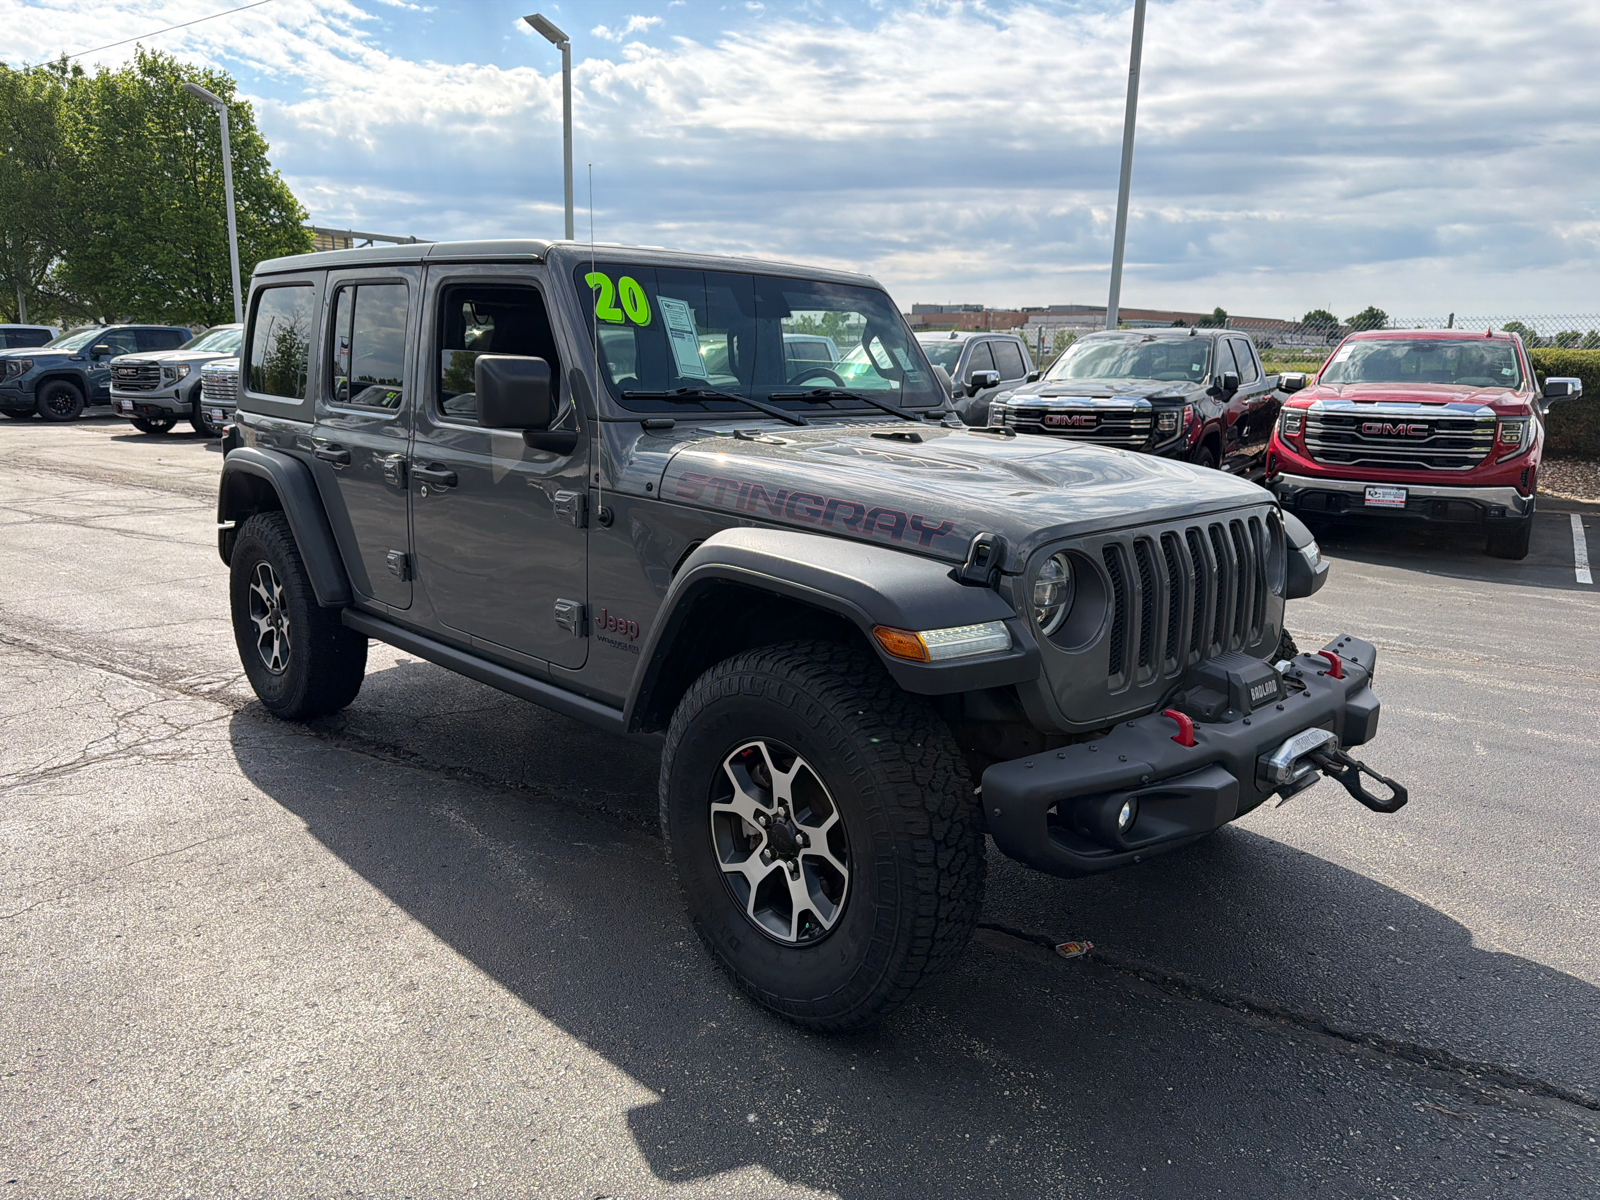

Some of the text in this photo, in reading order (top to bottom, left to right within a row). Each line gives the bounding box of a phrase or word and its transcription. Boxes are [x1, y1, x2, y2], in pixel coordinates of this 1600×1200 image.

[584, 271, 652, 327] 20
[1044, 414, 1097, 426] GMC
[1362, 422, 1428, 436] GMC
[674, 471, 956, 548] STINGRAY
[595, 608, 639, 641] Jeep
[597, 635, 640, 652] WRANGLER
[1250, 680, 1277, 701] BADLAND
